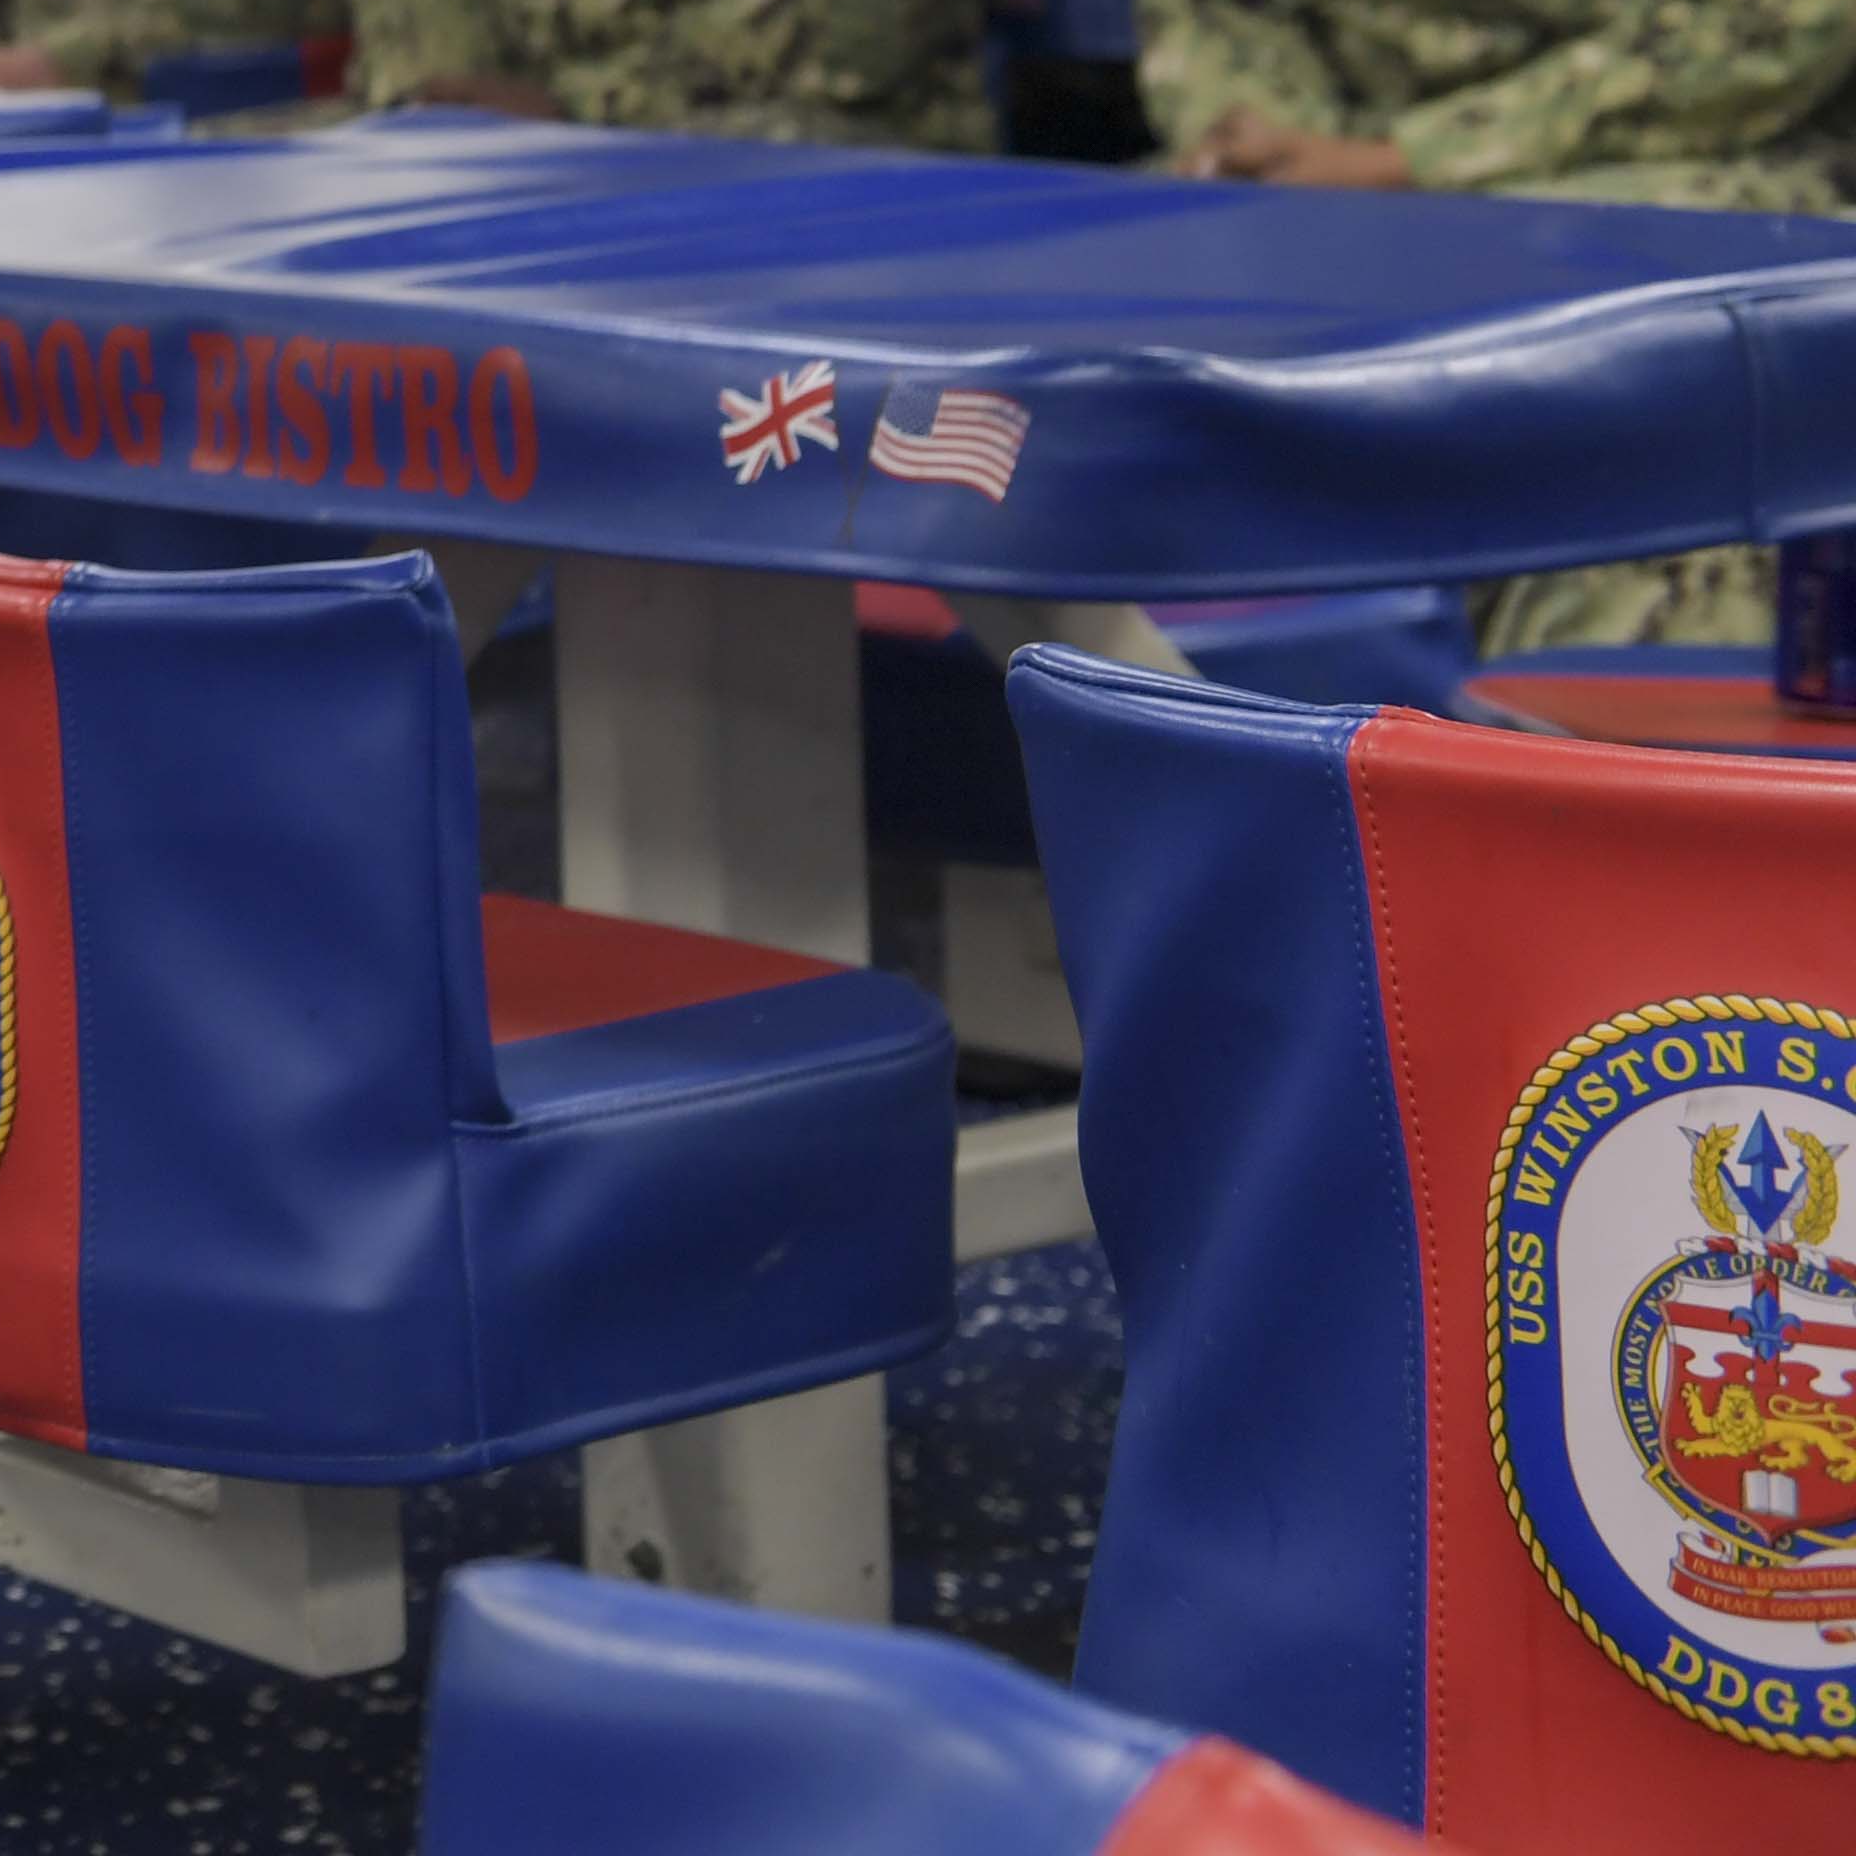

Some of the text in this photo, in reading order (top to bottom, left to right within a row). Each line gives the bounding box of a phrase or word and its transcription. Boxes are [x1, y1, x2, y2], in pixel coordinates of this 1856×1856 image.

[189, 332, 539, 503] BISTRO
[1513, 1031, 1745, 1207] WINSTON
[1507, 1231, 1548, 1345] USS
[1624, 1314, 1653, 1390] MOST
[1729, 1254, 1829, 1297] ORDER
[1657, 1634, 1800, 1727] DDG
